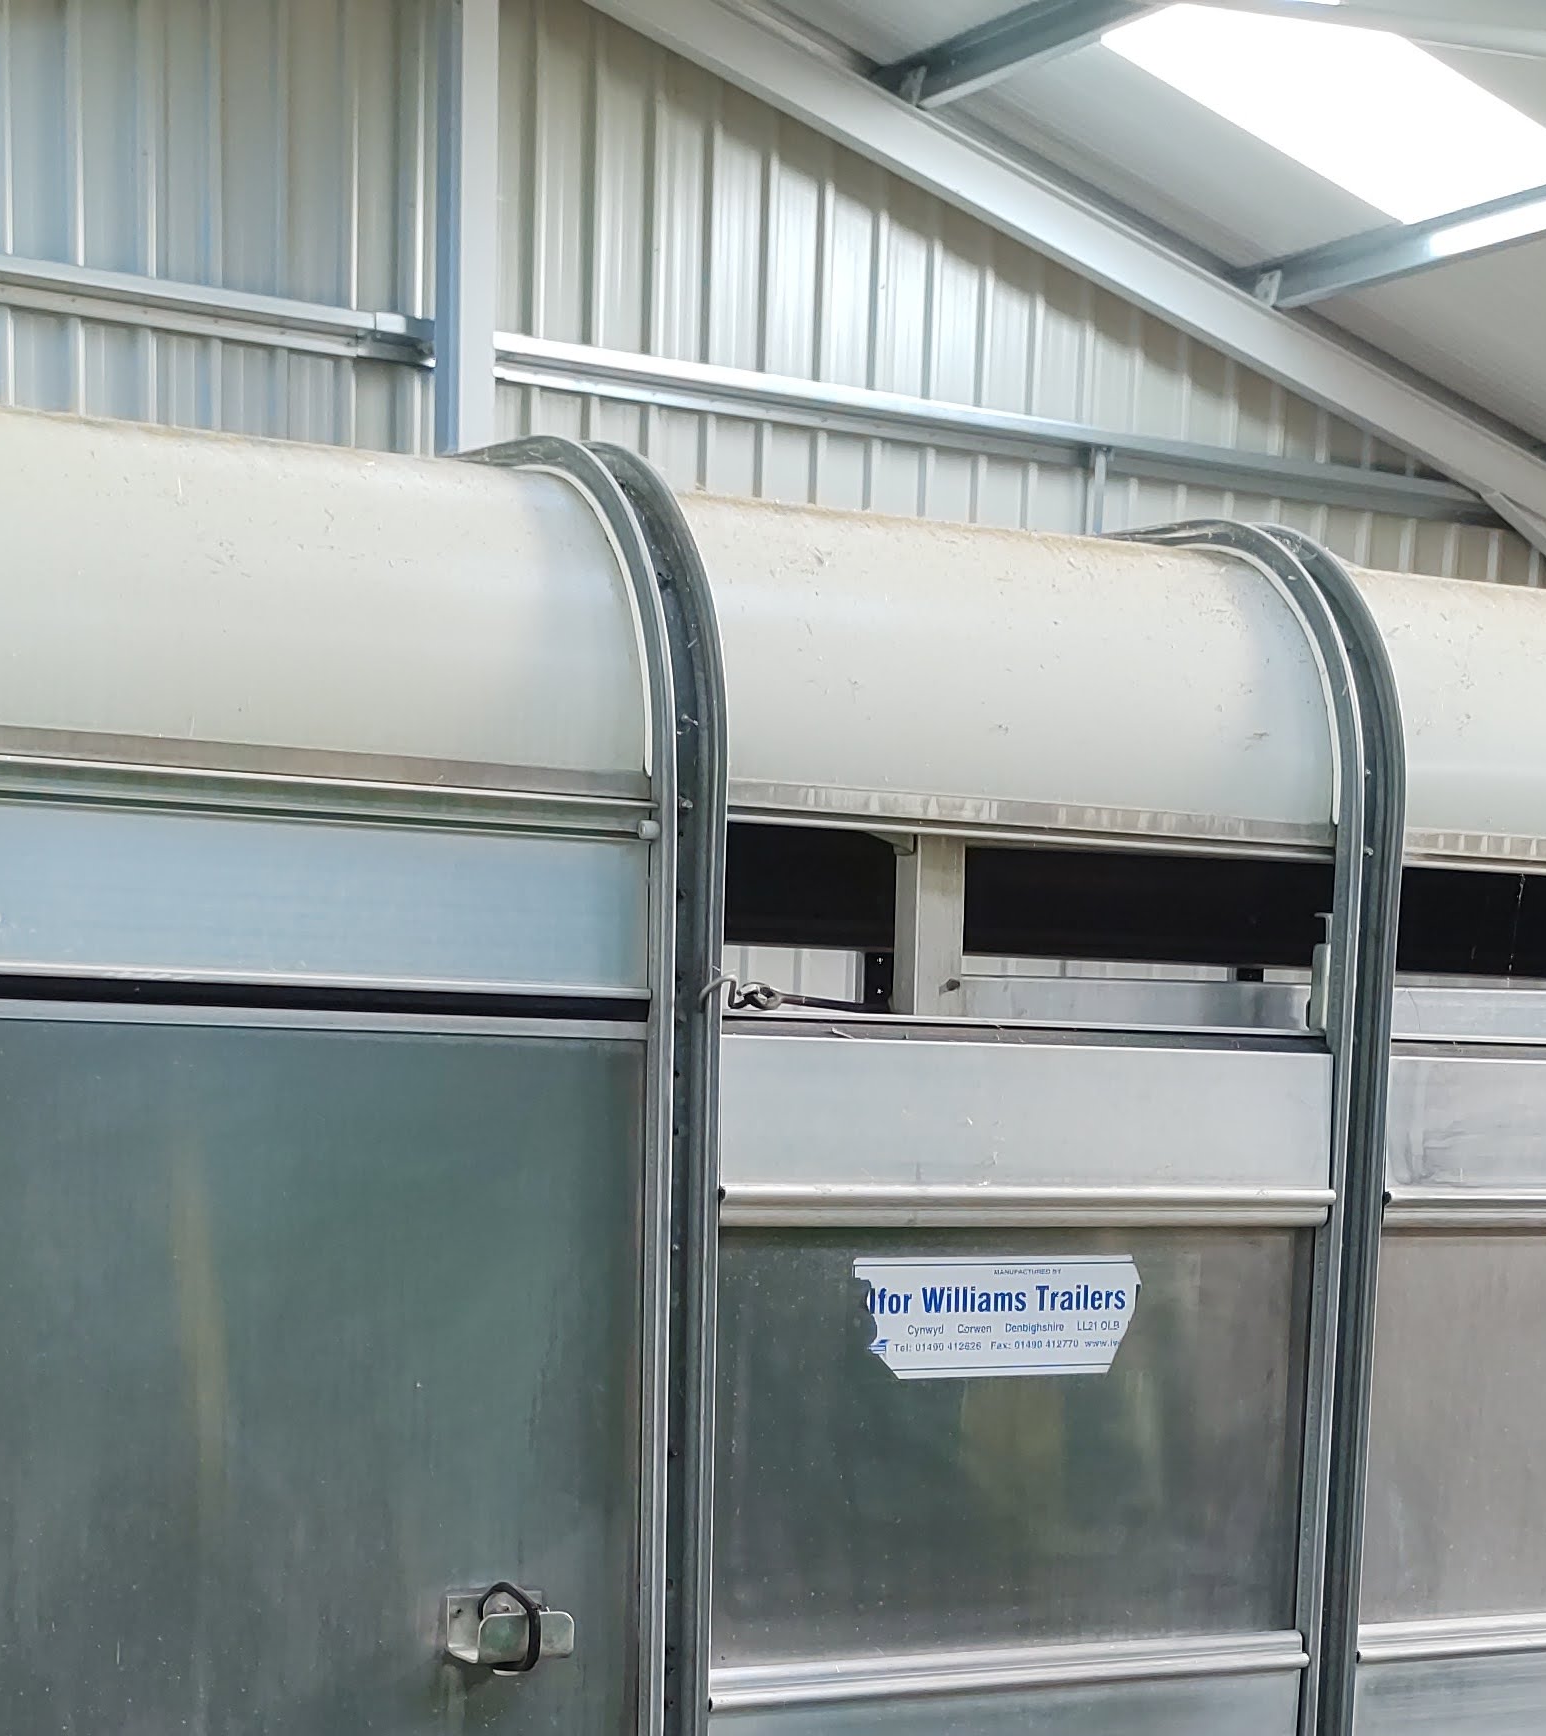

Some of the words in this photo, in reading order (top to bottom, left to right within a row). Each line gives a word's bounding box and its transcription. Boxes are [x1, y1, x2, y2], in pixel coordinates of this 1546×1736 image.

[869, 1287, 912, 1314] Ifor
[921, 1286, 1027, 1313] Williams
[1035, 1284, 1126, 1311] Trailers
[907, 1324, 944, 1336] Cynwyd
[957, 1323, 992, 1333] Corwen
[1005, 1322, 1065, 1335] Denbighshire
[1077, 1320, 1097, 1331] LL21
[893, 1343, 912, 1352] Tel:
[915, 1342, 944, 1352] 01490
[1014, 1340, 1043, 1350] 01490
[1045, 1339, 1079, 1349] 412770
